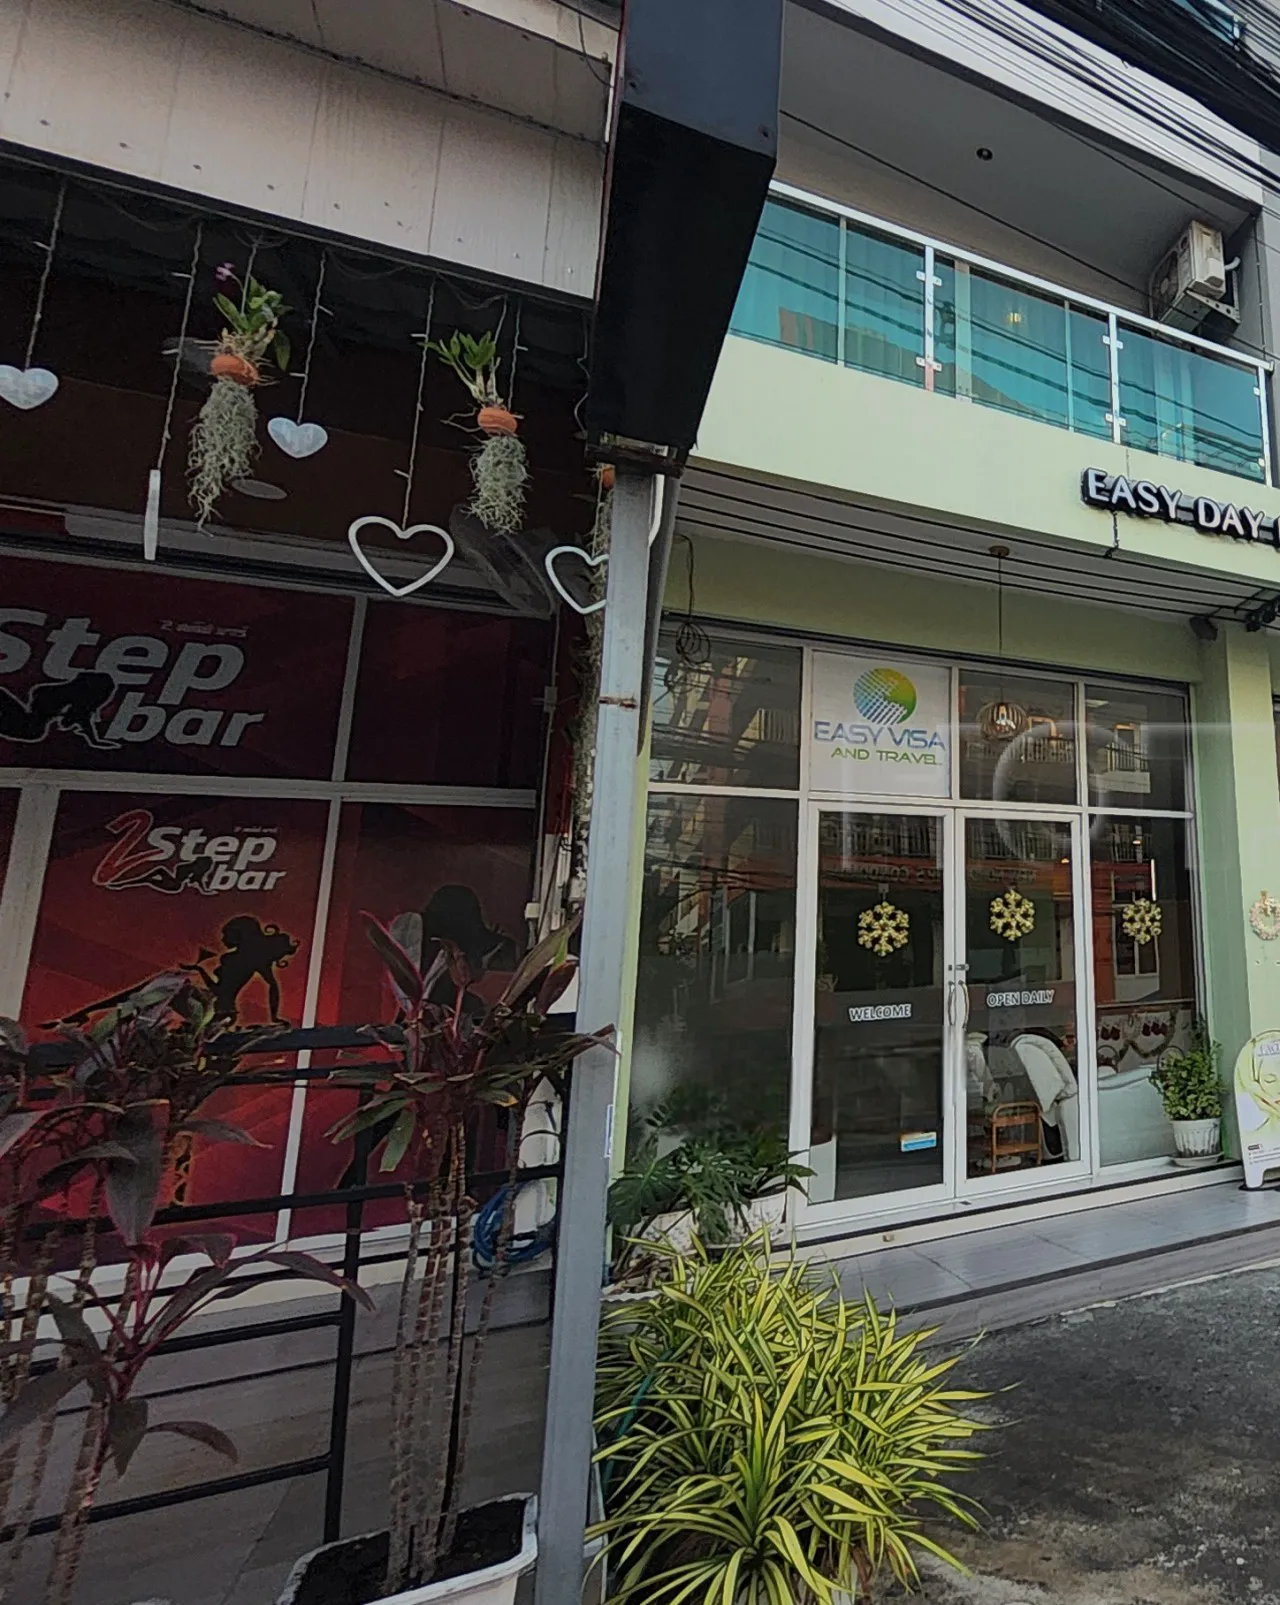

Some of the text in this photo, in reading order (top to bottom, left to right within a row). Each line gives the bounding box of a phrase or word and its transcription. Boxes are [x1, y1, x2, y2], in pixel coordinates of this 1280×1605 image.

[1085, 468, 1183, 521] EASY
[1197, 497, 1266, 540] DAY
[104, 691, 265, 747] bar
[814, 720, 946, 751] EASY VISA
[831, 747, 943, 766] AND TRAVEL
[209, 864, 286, 891] bar
[987, 989, 1055, 1007] OPEN DAILY
[849, 1003, 911, 1022] WELCOME
